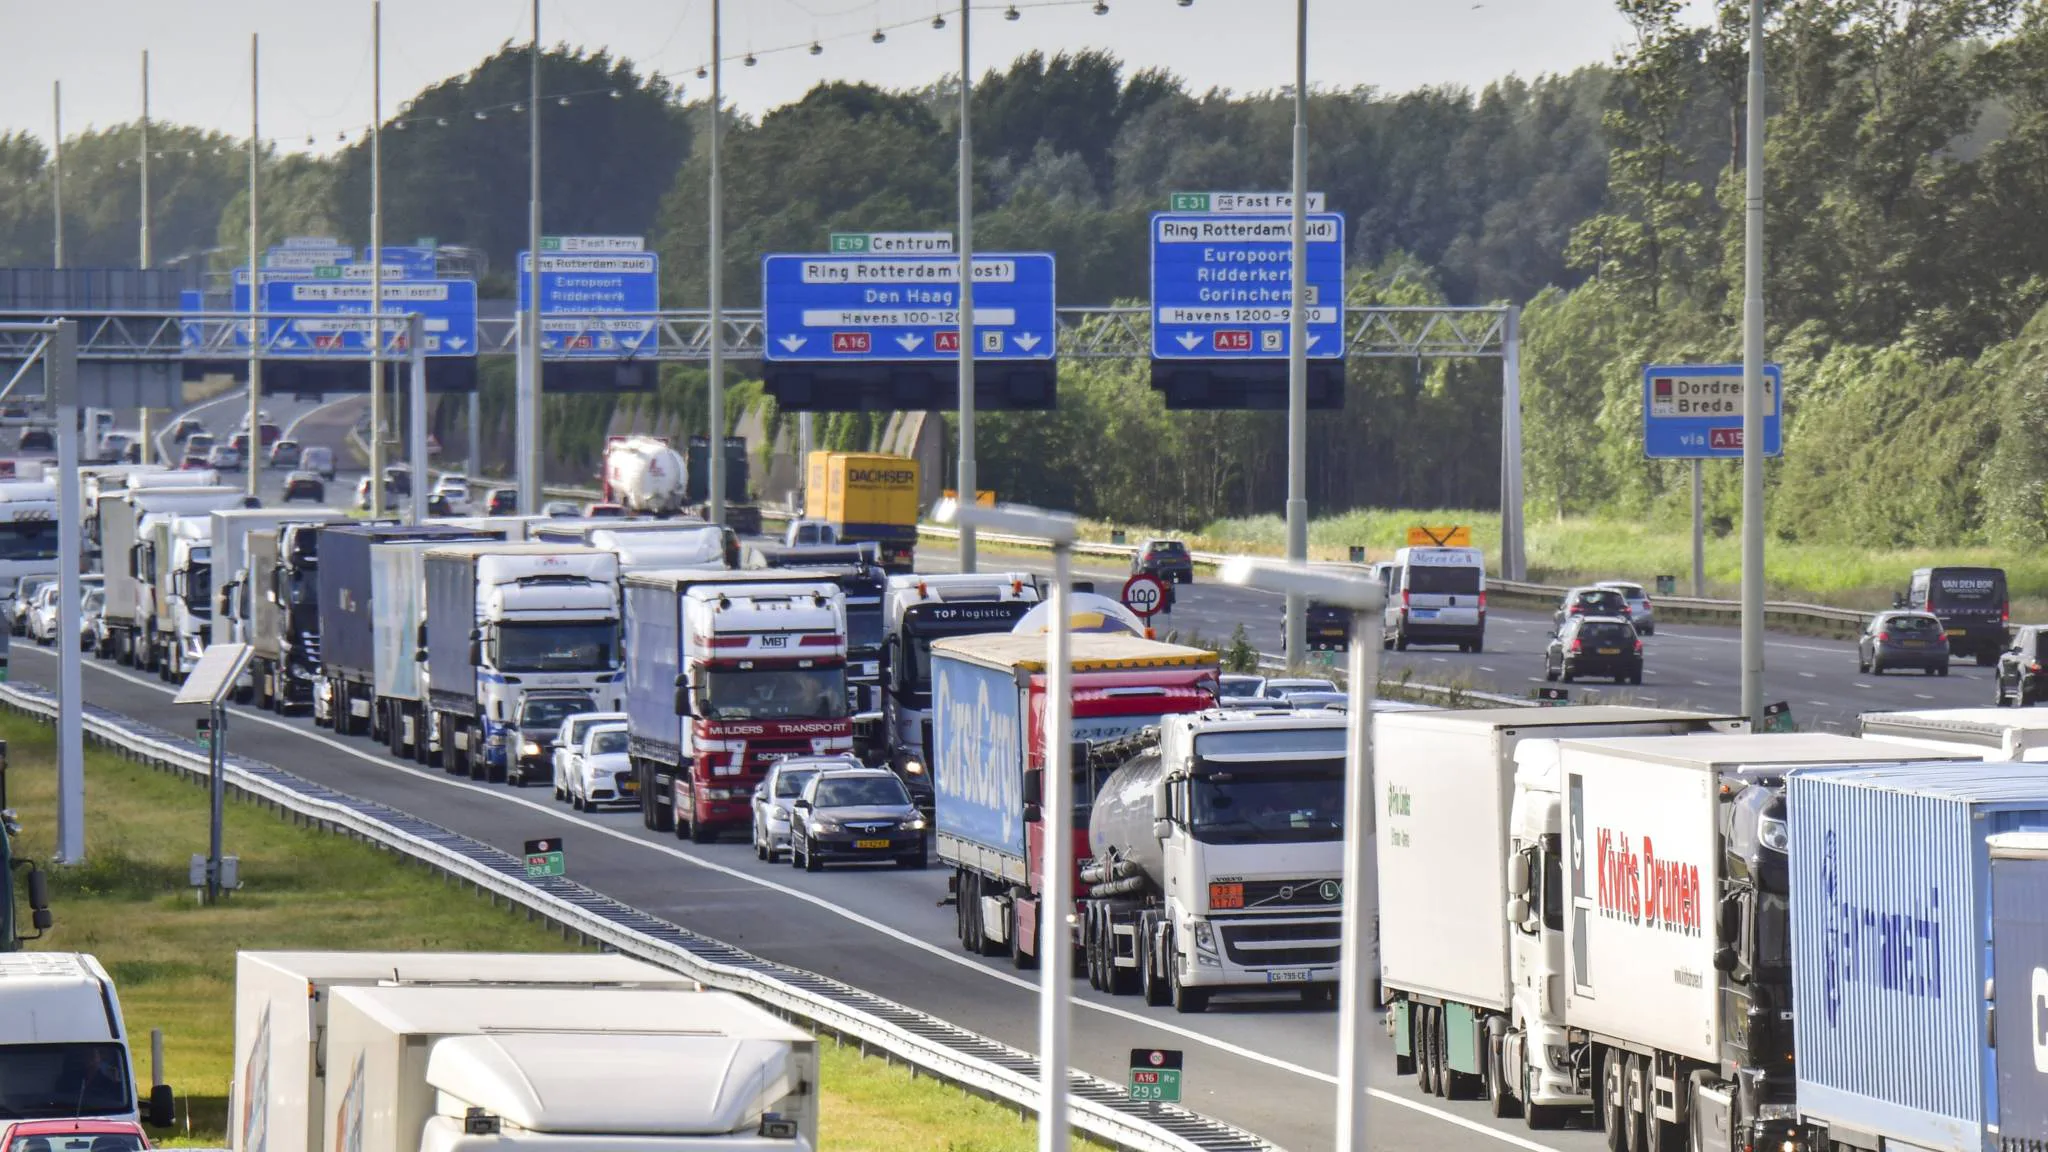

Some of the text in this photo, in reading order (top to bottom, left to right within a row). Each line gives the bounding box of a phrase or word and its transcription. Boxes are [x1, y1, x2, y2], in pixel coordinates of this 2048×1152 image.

[1177, 197, 1206, 209] E31
[1237, 196, 1269, 207] Fast
[1276, 196, 1316, 209] Fey
[1164, 223, 1332, 240] Ring Rotterdam (uid)
[838, 237, 951, 250] E19 Centrum
[1204, 248, 1293, 264] Europoort
[808, 264, 1010, 281] Ring Rotterdam (ost)
[866, 290, 953, 306] Den Haag
[842, 312, 898, 324] Havens
[1174, 310, 1321, 321] Havens 1200-900
[837, 336, 866, 349] A16
[939, 336, 960, 348] A1
[1218, 336, 1276, 347] A15 9
[1679, 381, 1771, 394] Dordret
[1679, 399, 1734, 412] Breda
[1680, 433, 1705, 446] via
[848, 469, 914, 483] DACHSER
[1942, 579, 1958, 588] VAN
[1131, 588, 1157, 603] 100
[934, 608, 1012, 619] TOP logistics
[709, 723, 847, 735] MULDERS TRANSPORT
[1597, 826, 1701, 937] Kivits Drunen
[1138, 1072, 1155, 1083] A16
